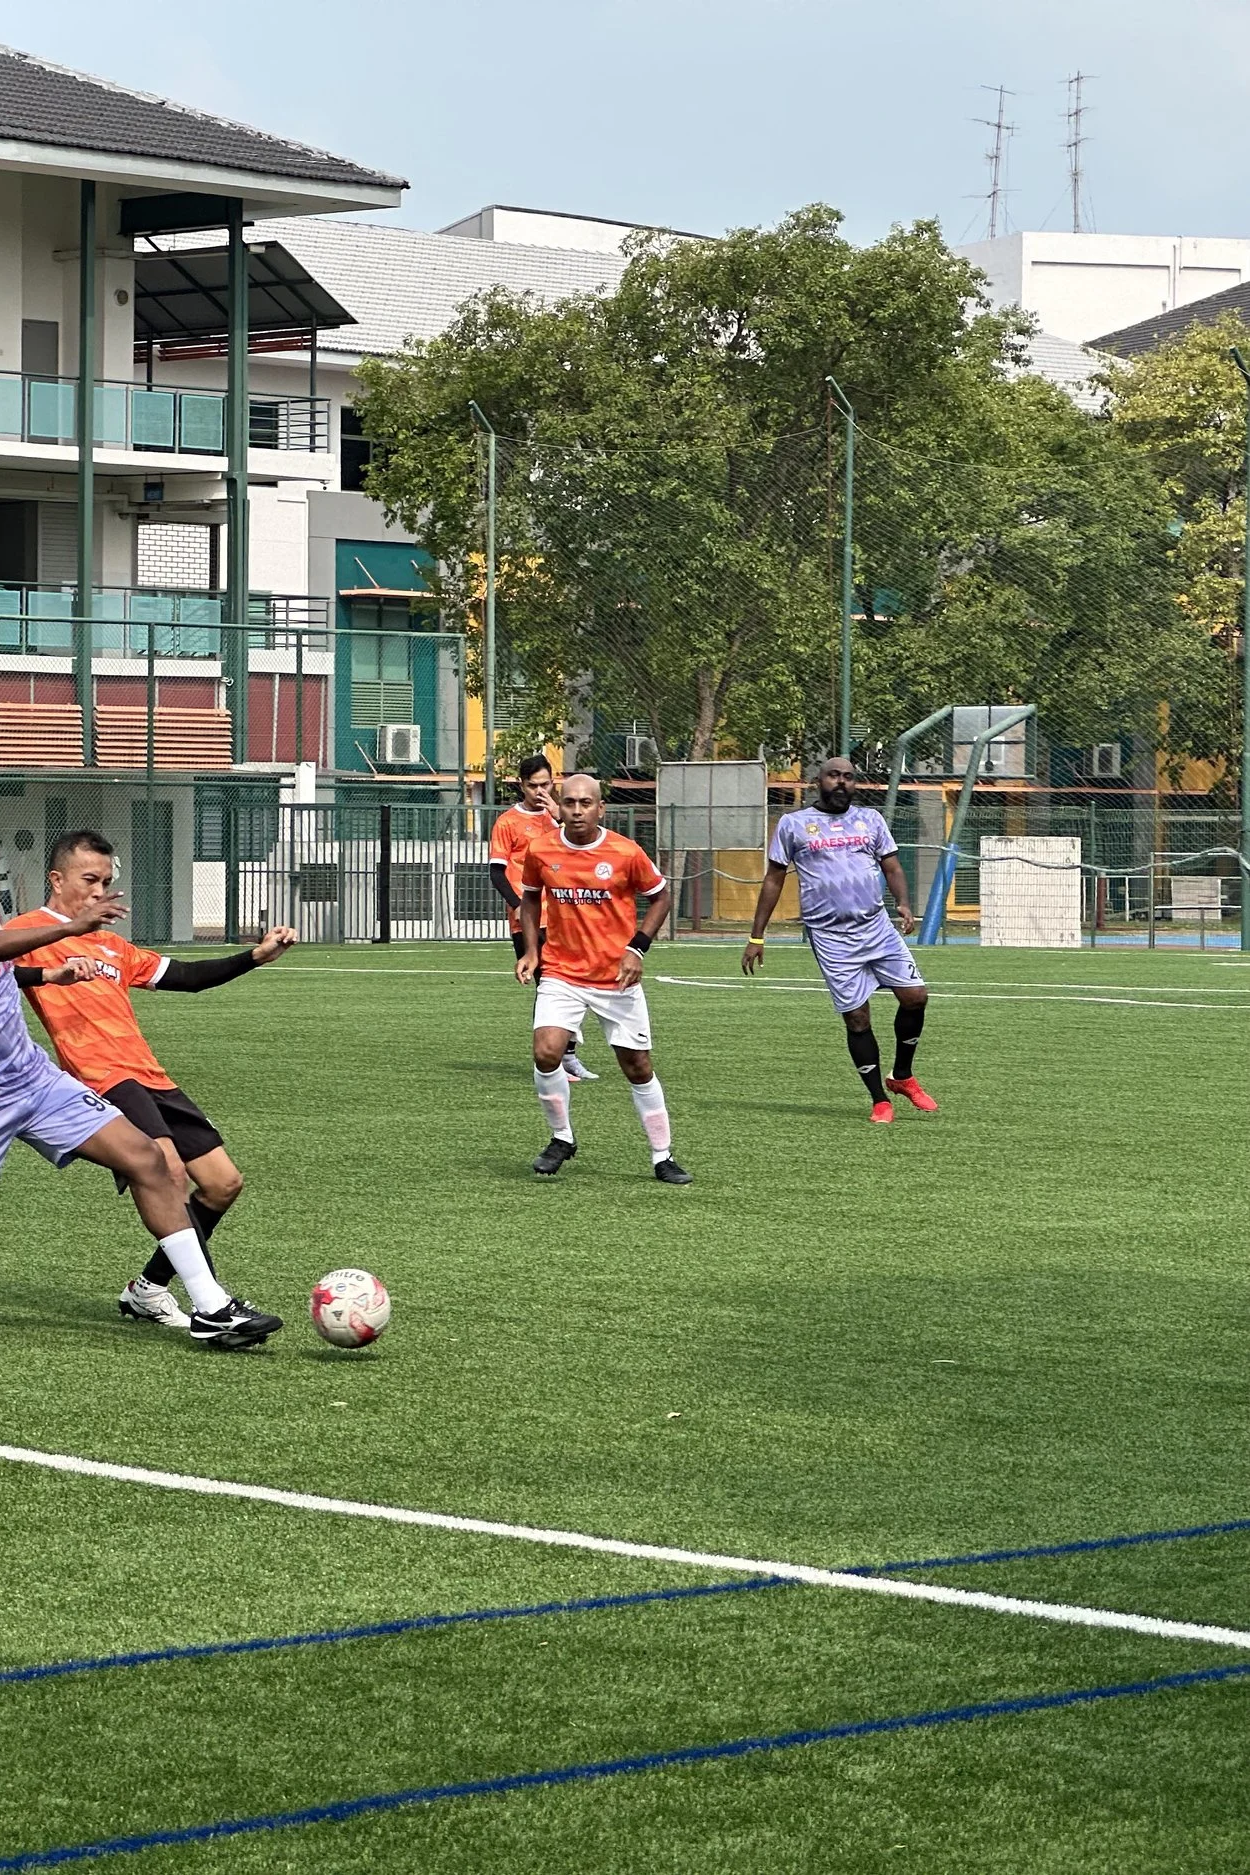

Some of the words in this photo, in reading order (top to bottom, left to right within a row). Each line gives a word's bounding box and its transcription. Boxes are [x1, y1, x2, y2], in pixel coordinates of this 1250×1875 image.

[808, 836, 871, 852] MAESTRO
[551, 888, 574, 899] TIKI
[576, 888, 612, 900] TAKA
